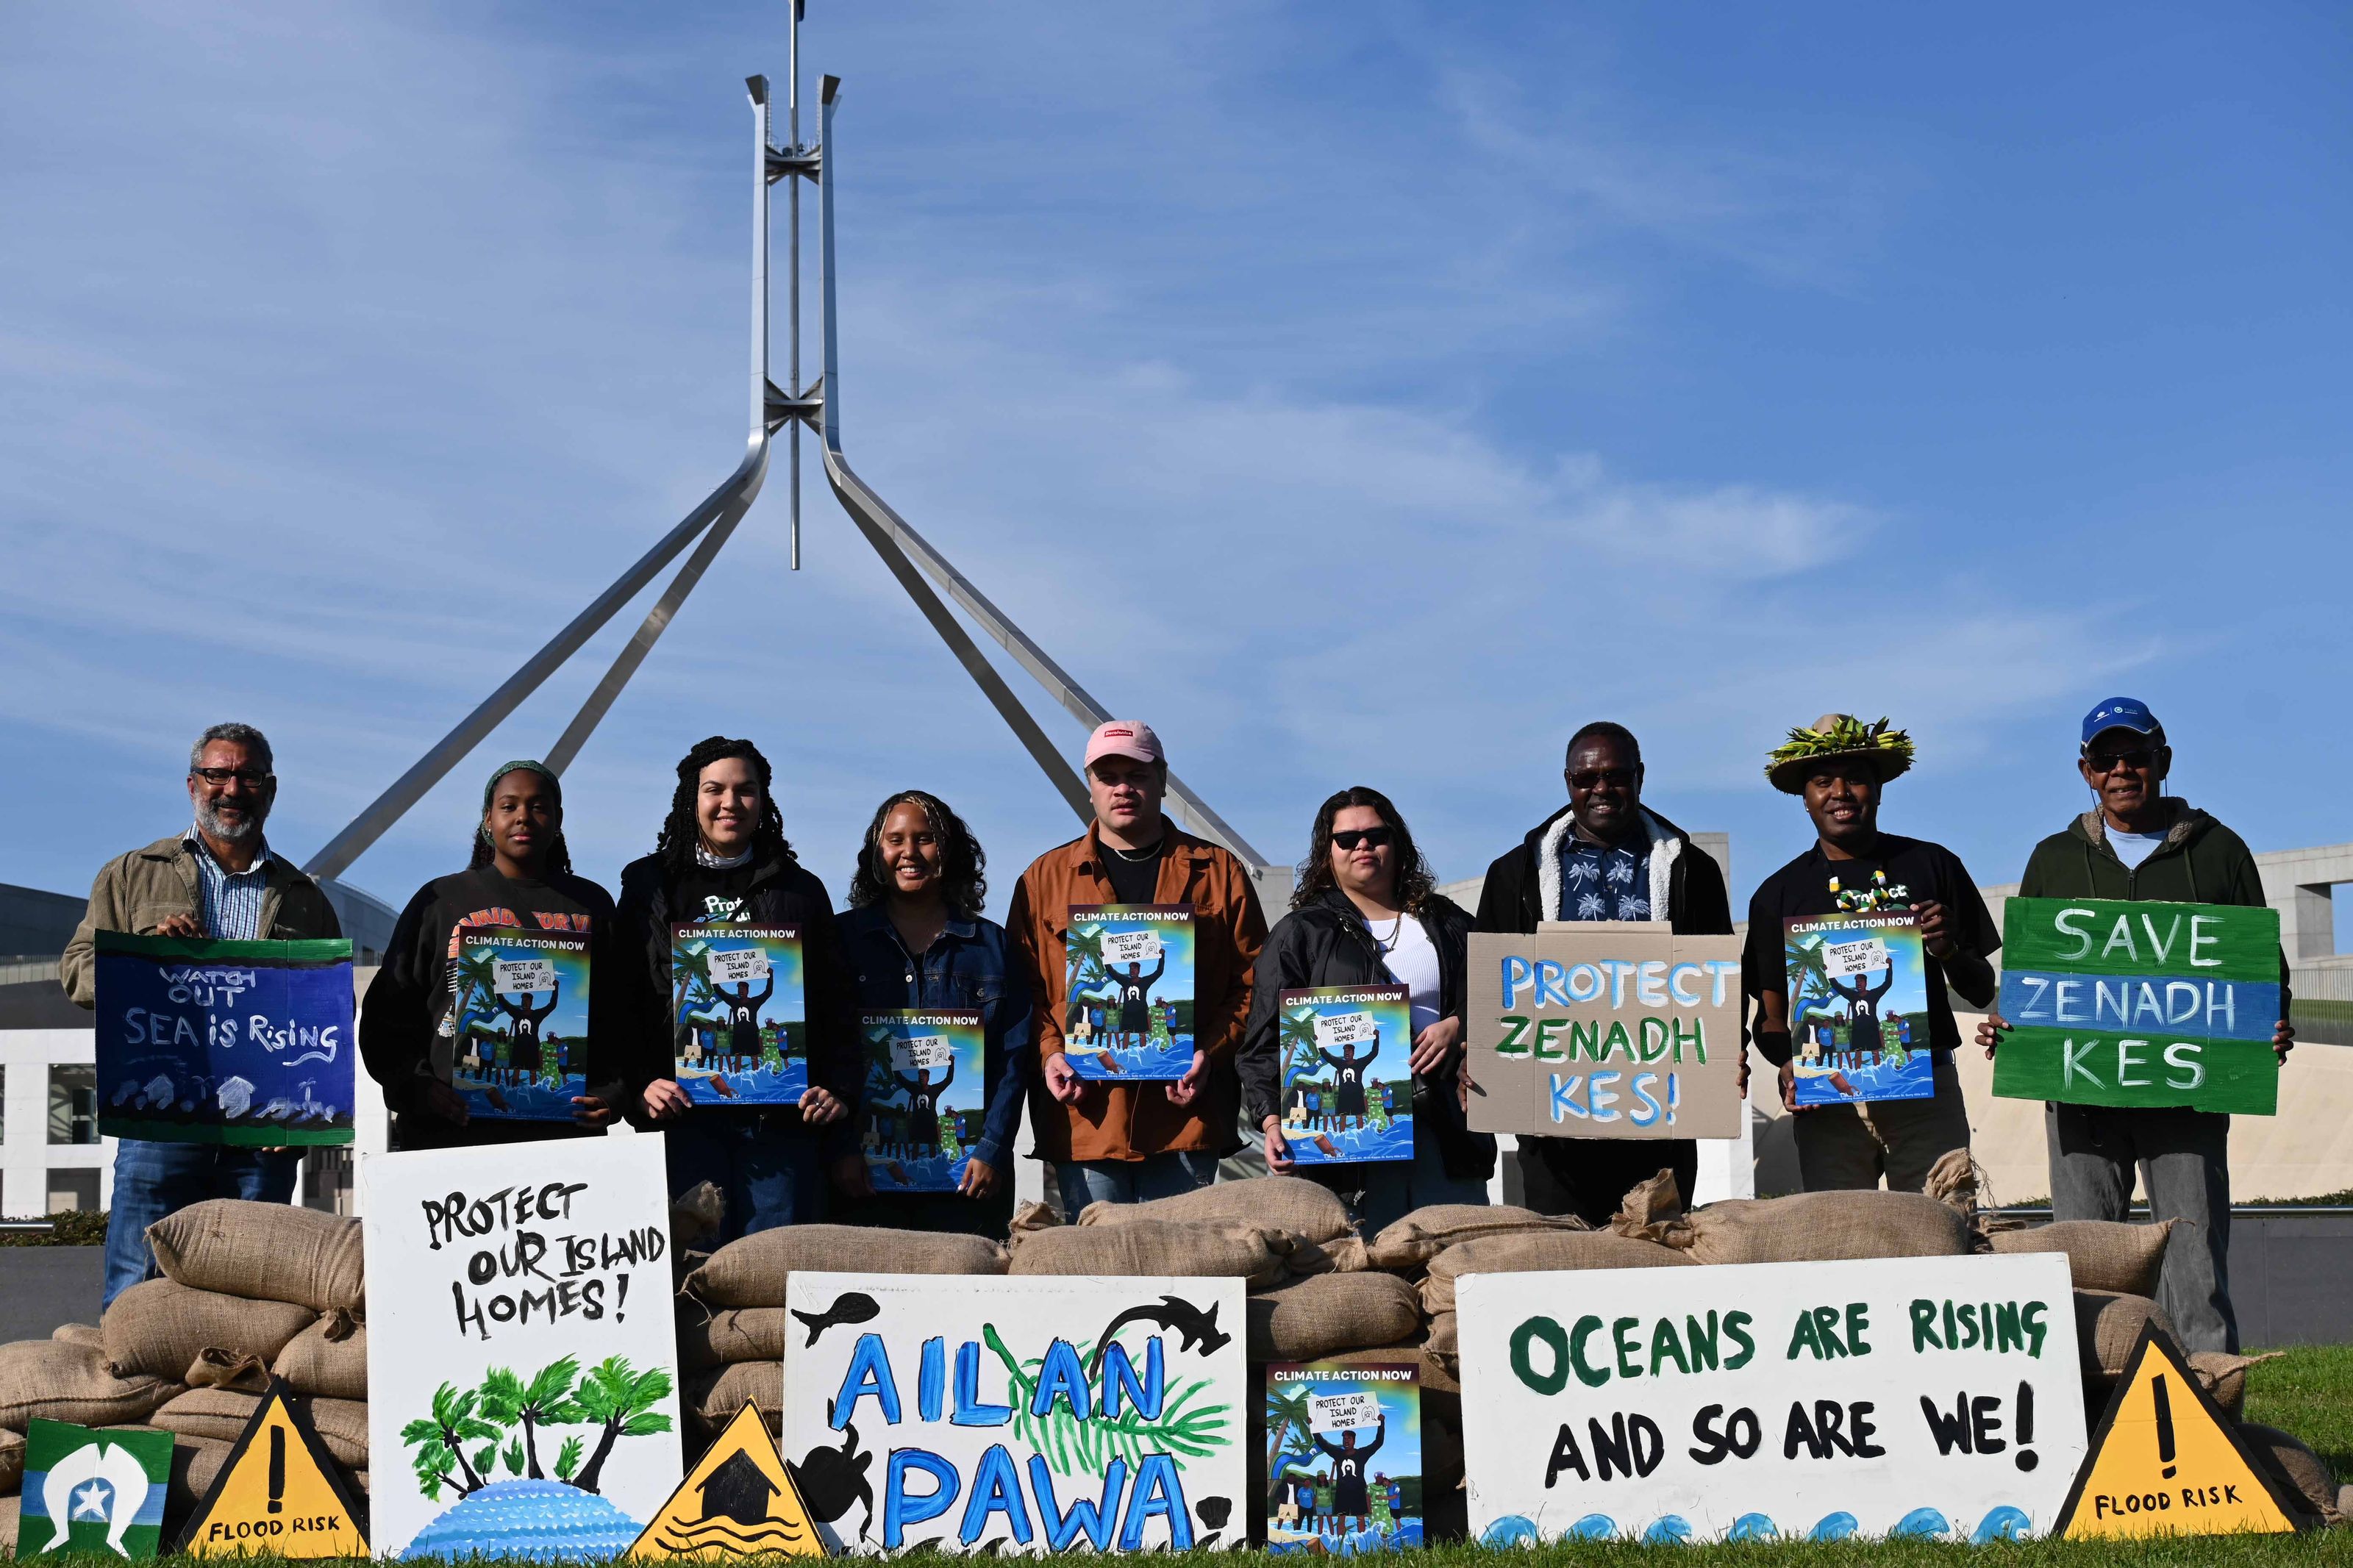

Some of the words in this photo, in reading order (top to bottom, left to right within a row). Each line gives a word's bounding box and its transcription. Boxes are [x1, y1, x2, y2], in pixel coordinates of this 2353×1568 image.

[1074, 912, 1120, 921] CLIMATE
[1121, 912, 1163, 921] ACTION
[1164, 912, 1189, 920] NOW
[1791, 922, 1840, 933] CLIMATE
[1843, 919, 1885, 930] ACTION
[1888, 917, 1915, 927] NOW
[679, 930, 725, 938] CLIMATE
[728, 930, 768, 938] ACTION
[771, 930, 796, 938] NOW
[1107, 935, 1133, 945] PROTECT
[2053, 908, 2225, 967] SAVE
[465, 936, 513, 947] CLIMATE
[515, 939, 557, 949] ACTION
[559, 941, 585, 951] NOW
[1119, 943, 1142, 951] ISLAND
[1829, 945, 1857, 956] PROTECT
[1860, 942, 1874, 951] OUR
[714, 953, 740, 963] PROTECT
[1843, 953, 1867, 963] ISLAND
[500, 963, 526, 972] PROTECT
[726, 962, 749, 970] ISLAND
[1845, 962, 1866, 973] HOMES
[512, 973, 535, 981] ISLAND
[728, 971, 748, 979] HOMES
[513, 982, 533, 990] HOMES
[1502, 956, 1741, 1010] PROTECT
[168, 984, 246, 1007] OUT
[1285, 995, 1332, 1006] CLIMATE
[1335, 994, 1375, 1003] ACTION
[1377, 992, 1402, 1001] NOW
[2018, 976, 2235, 1033] ZENADH
[862, 1016, 908, 1025] CLIMATE
[910, 1016, 951, 1025] ACTION
[953, 1017, 978, 1025] NOW
[1321, 1017, 1346, 1027] PROTECT
[125, 1007, 199, 1047] SEA
[1333, 1025, 1355, 1034] ISLAND
[1335, 1034, 1354, 1042] HOMES
[1495, 1015, 1707, 1065] ZENADH
[896, 1039, 922, 1050] PROTECT
[926, 1039, 938, 1047] OUR
[909, 1049, 931, 1058] ISLAND
[910, 1059, 929, 1067] HOMES
[2064, 1037, 2206, 1091] KES
[1549, 1070, 1680, 1128] KES!
[422, 1182, 588, 1250] PROTECT
[468, 1229, 558, 1285] OUR
[556, 1226, 665, 1277] ISLAND
[452, 1273, 629, 1341] HOMES!
[1509, 1309, 1756, 1395] OCEANS
[1786, 1302, 1872, 1361] ARE
[1909, 1299, 2048, 1360] RISING
[1274, 1370, 1329, 1381] CLIMATE
[1332, 1370, 1379, 1381] ACTION
[1382, 1370, 1412, 1381] NOW
[831, 1333, 1164, 1431] AILAN
[1315, 1398, 1346, 1409] PROTECT
[1350, 1396, 1365, 1405] OUR
[1330, 1408, 1357, 1417] ISLAND
[1332, 1419, 1355, 1428] HOMES
[1544, 1411, 1665, 1489] AND
[1688, 1403, 1763, 1465] SO
[1783, 1400, 1886, 1460] ARE
[1919, 1379, 2040, 1472] WE!
[882, 1444, 1195, 1553] PAWA
[2095, 1492, 2171, 1519] FLOOD
[2182, 1485, 2243, 1508] RISK
[209, 1519, 284, 1542] FLOOD
[293, 1516, 340, 1531] RISK
